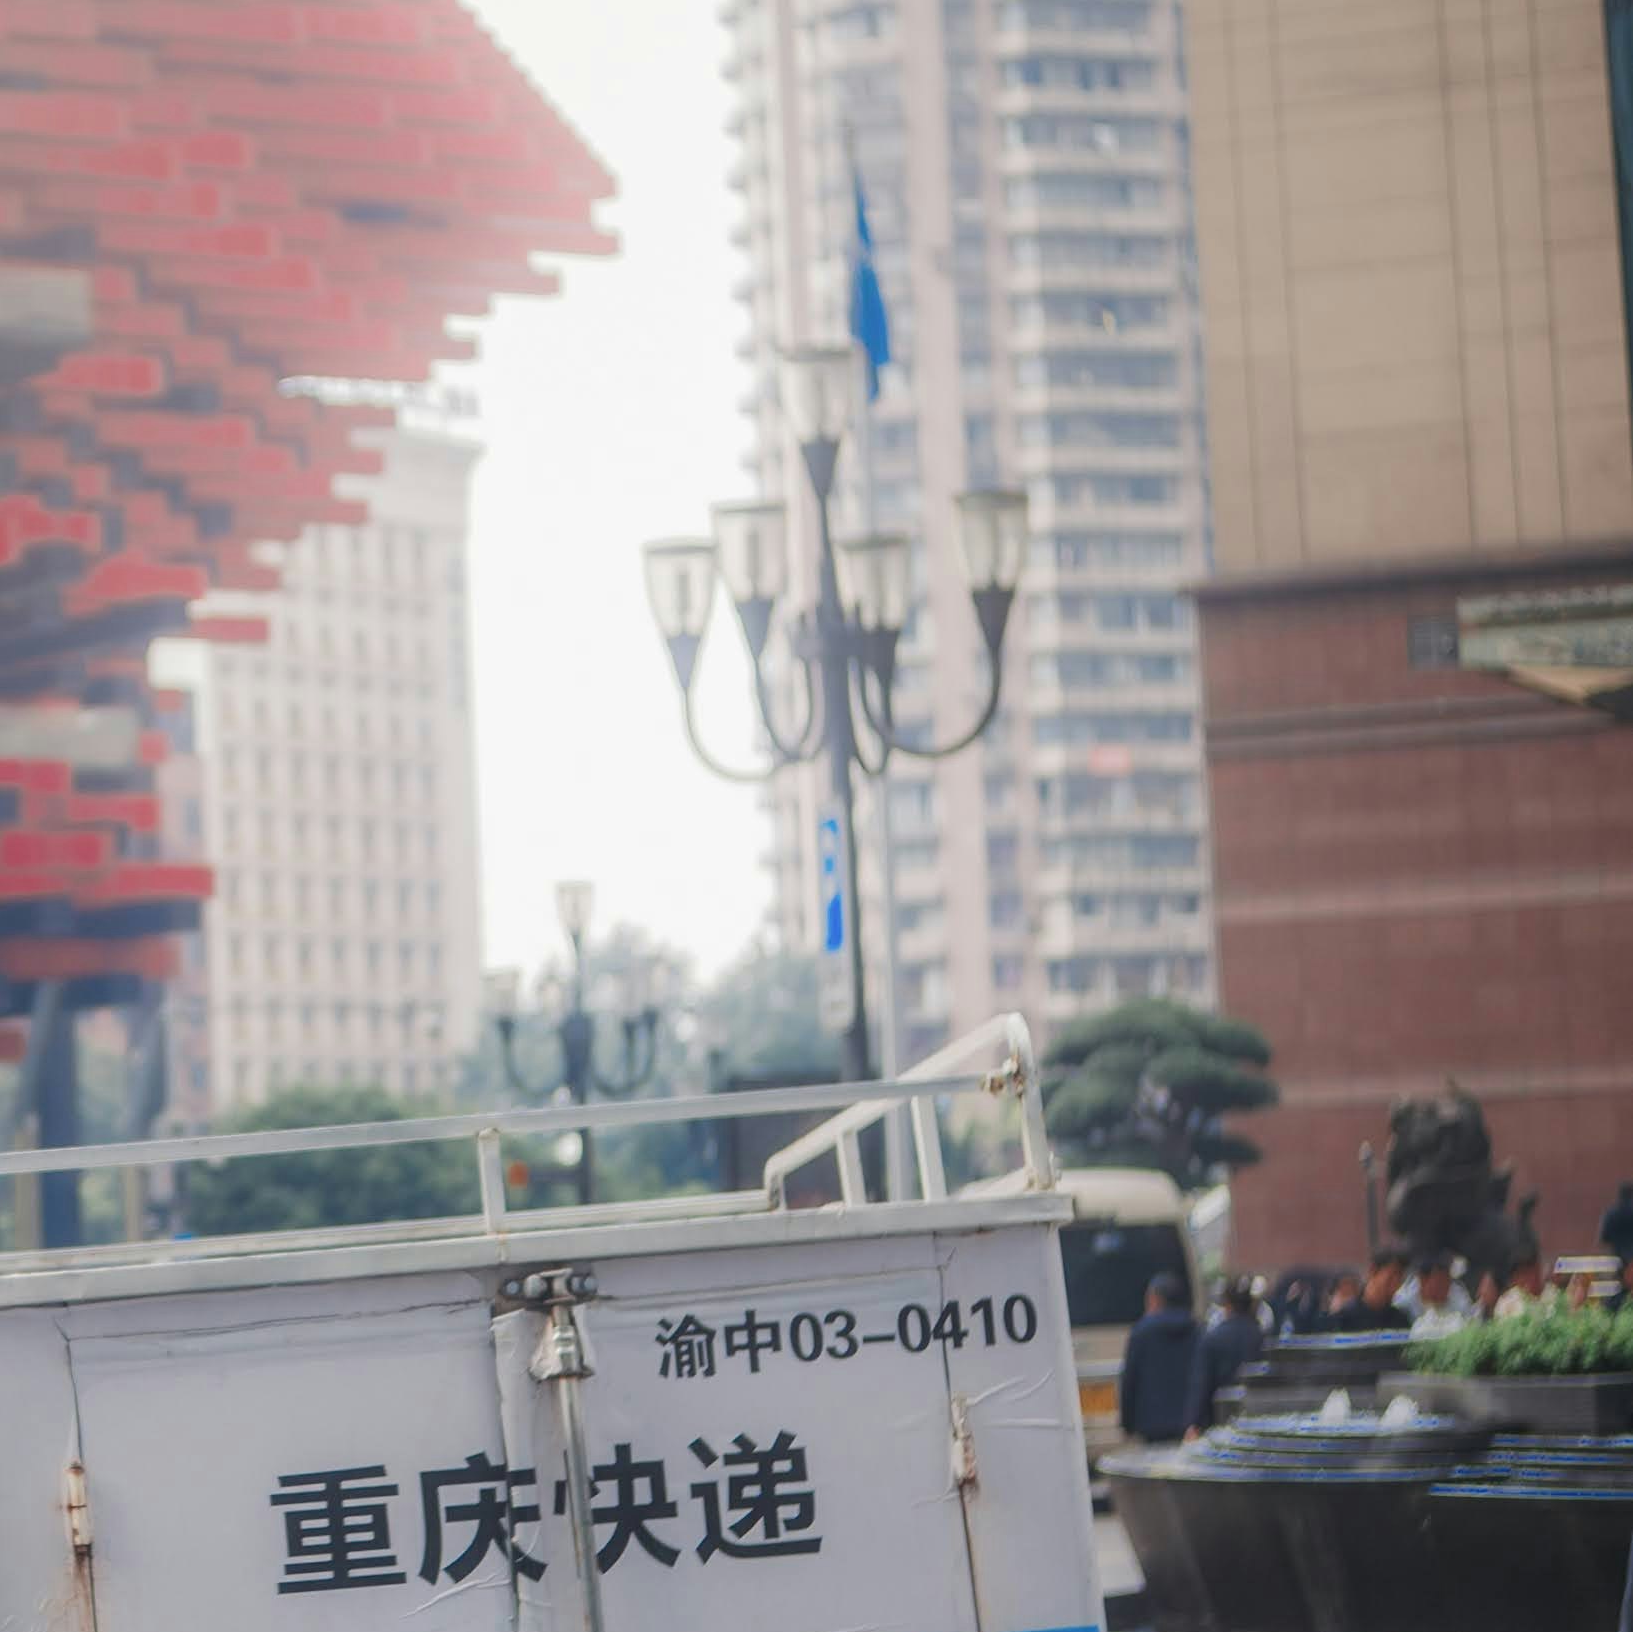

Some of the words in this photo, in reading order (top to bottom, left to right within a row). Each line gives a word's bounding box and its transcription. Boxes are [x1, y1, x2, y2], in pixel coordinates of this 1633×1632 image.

[655, 1293, 1038, 1379] 渝中03-0410
[270, 1429, 823, 1595] 重庆快递
